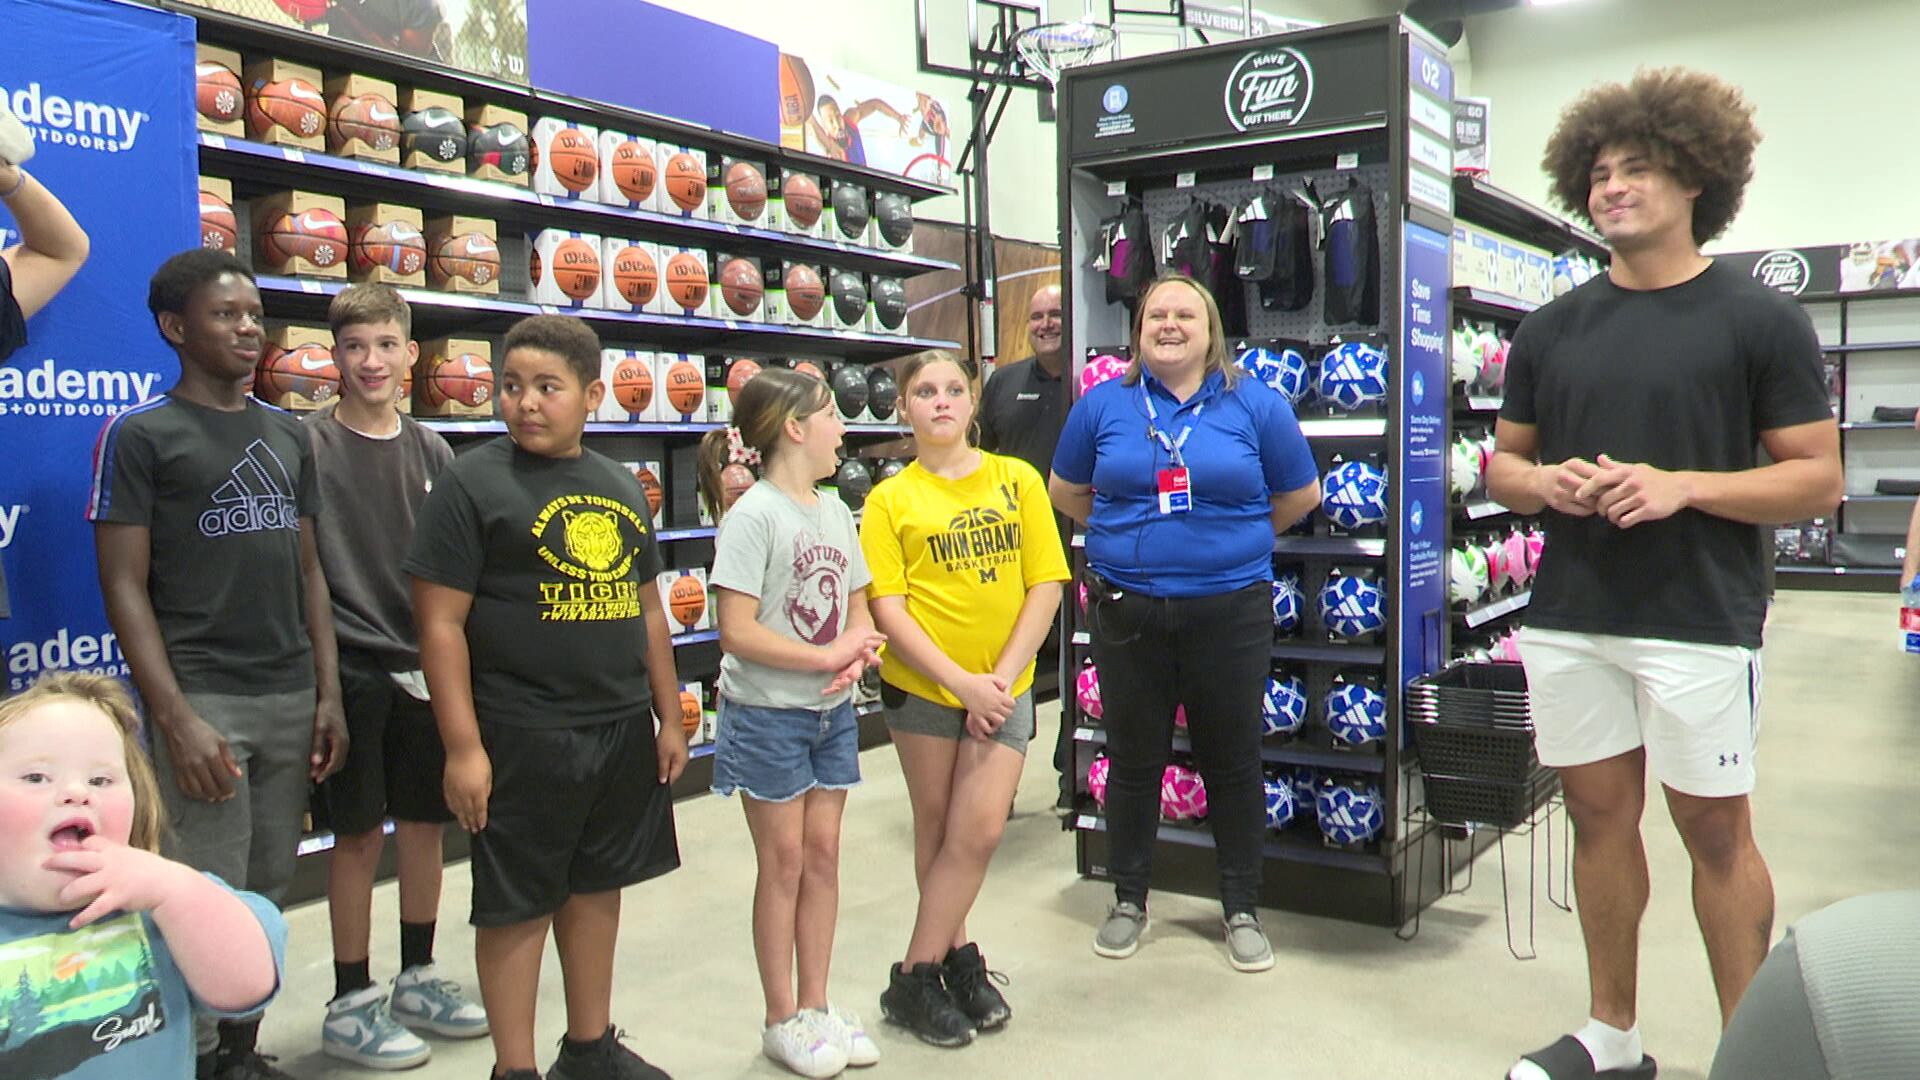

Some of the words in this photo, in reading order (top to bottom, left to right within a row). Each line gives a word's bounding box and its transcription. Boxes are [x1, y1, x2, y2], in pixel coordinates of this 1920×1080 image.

[1186, 10, 1263, 35] SILVERBK
[1253, 53, 1287, 68] HAVE
[1421, 56, 1441, 90] 02
[1239, 62, 1299, 112] Fun
[0, 83, 142, 150] demy
[1243, 113, 1262, 125] OUT
[1263, 109, 1293, 123] THERE
[27, 126, 118, 153] UTDOORS
[199, 494, 300, 537] adid
[926, 530, 971, 564] TWIN
[970, 521, 1021, 557] BRAN
[792, 545, 849, 574] FUTURE
[978, 567, 998, 584] M
[9, 628, 124, 674] ade
